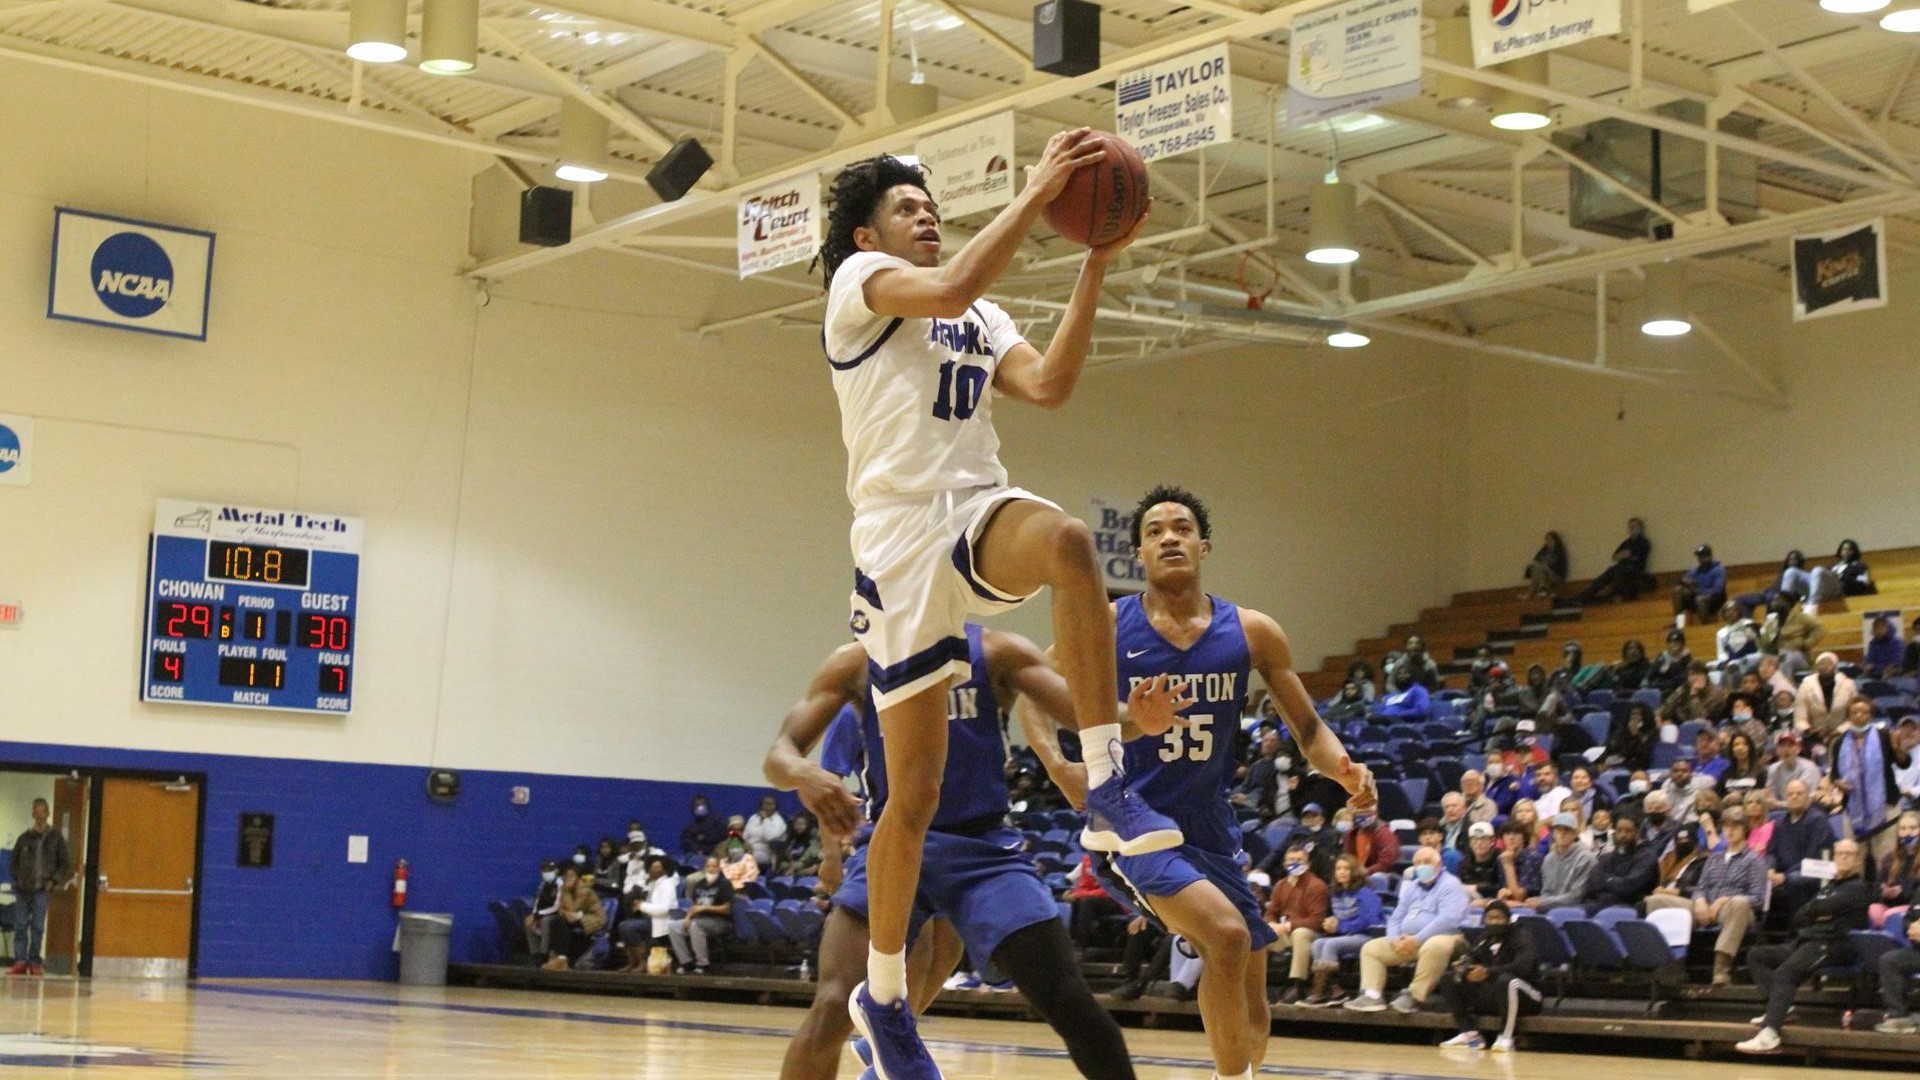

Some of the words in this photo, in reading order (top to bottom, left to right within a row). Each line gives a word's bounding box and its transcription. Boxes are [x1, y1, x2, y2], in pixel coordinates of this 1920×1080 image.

[1156, 57, 1224, 94] TAYLOR
[1118, 109, 1145, 135] Taylor
[1148, 104, 1182, 123] Freezer
[1185, 92, 1209, 114] Sales
[98, 269, 170, 301] NCAA
[932, 359, 988, 421] 10
[218, 507, 284, 527] Metal
[290, 513, 347, 533] Tech
[224, 547, 281, 582] 10.8
[159, 579, 224, 600] CHOWAN
[238, 595, 275, 609] PERIOD
[301, 592, 349, 611] GUEST
[168, 604, 210, 637] 29
[309, 616, 348, 650] 30
[153, 639, 187, 653] FOULS
[218, 645, 257, 659] PLAYER
[262, 647, 287, 661] FOUL
[164, 657, 180, 680] 4
[318, 652, 350, 665] FOULS
[332, 668, 344, 692] 7
[150, 686, 184, 698] SCORE
[233, 691, 269, 705] MATCH
[316, 697, 348, 710] SCORE
[1158, 714, 1214, 762] 35
